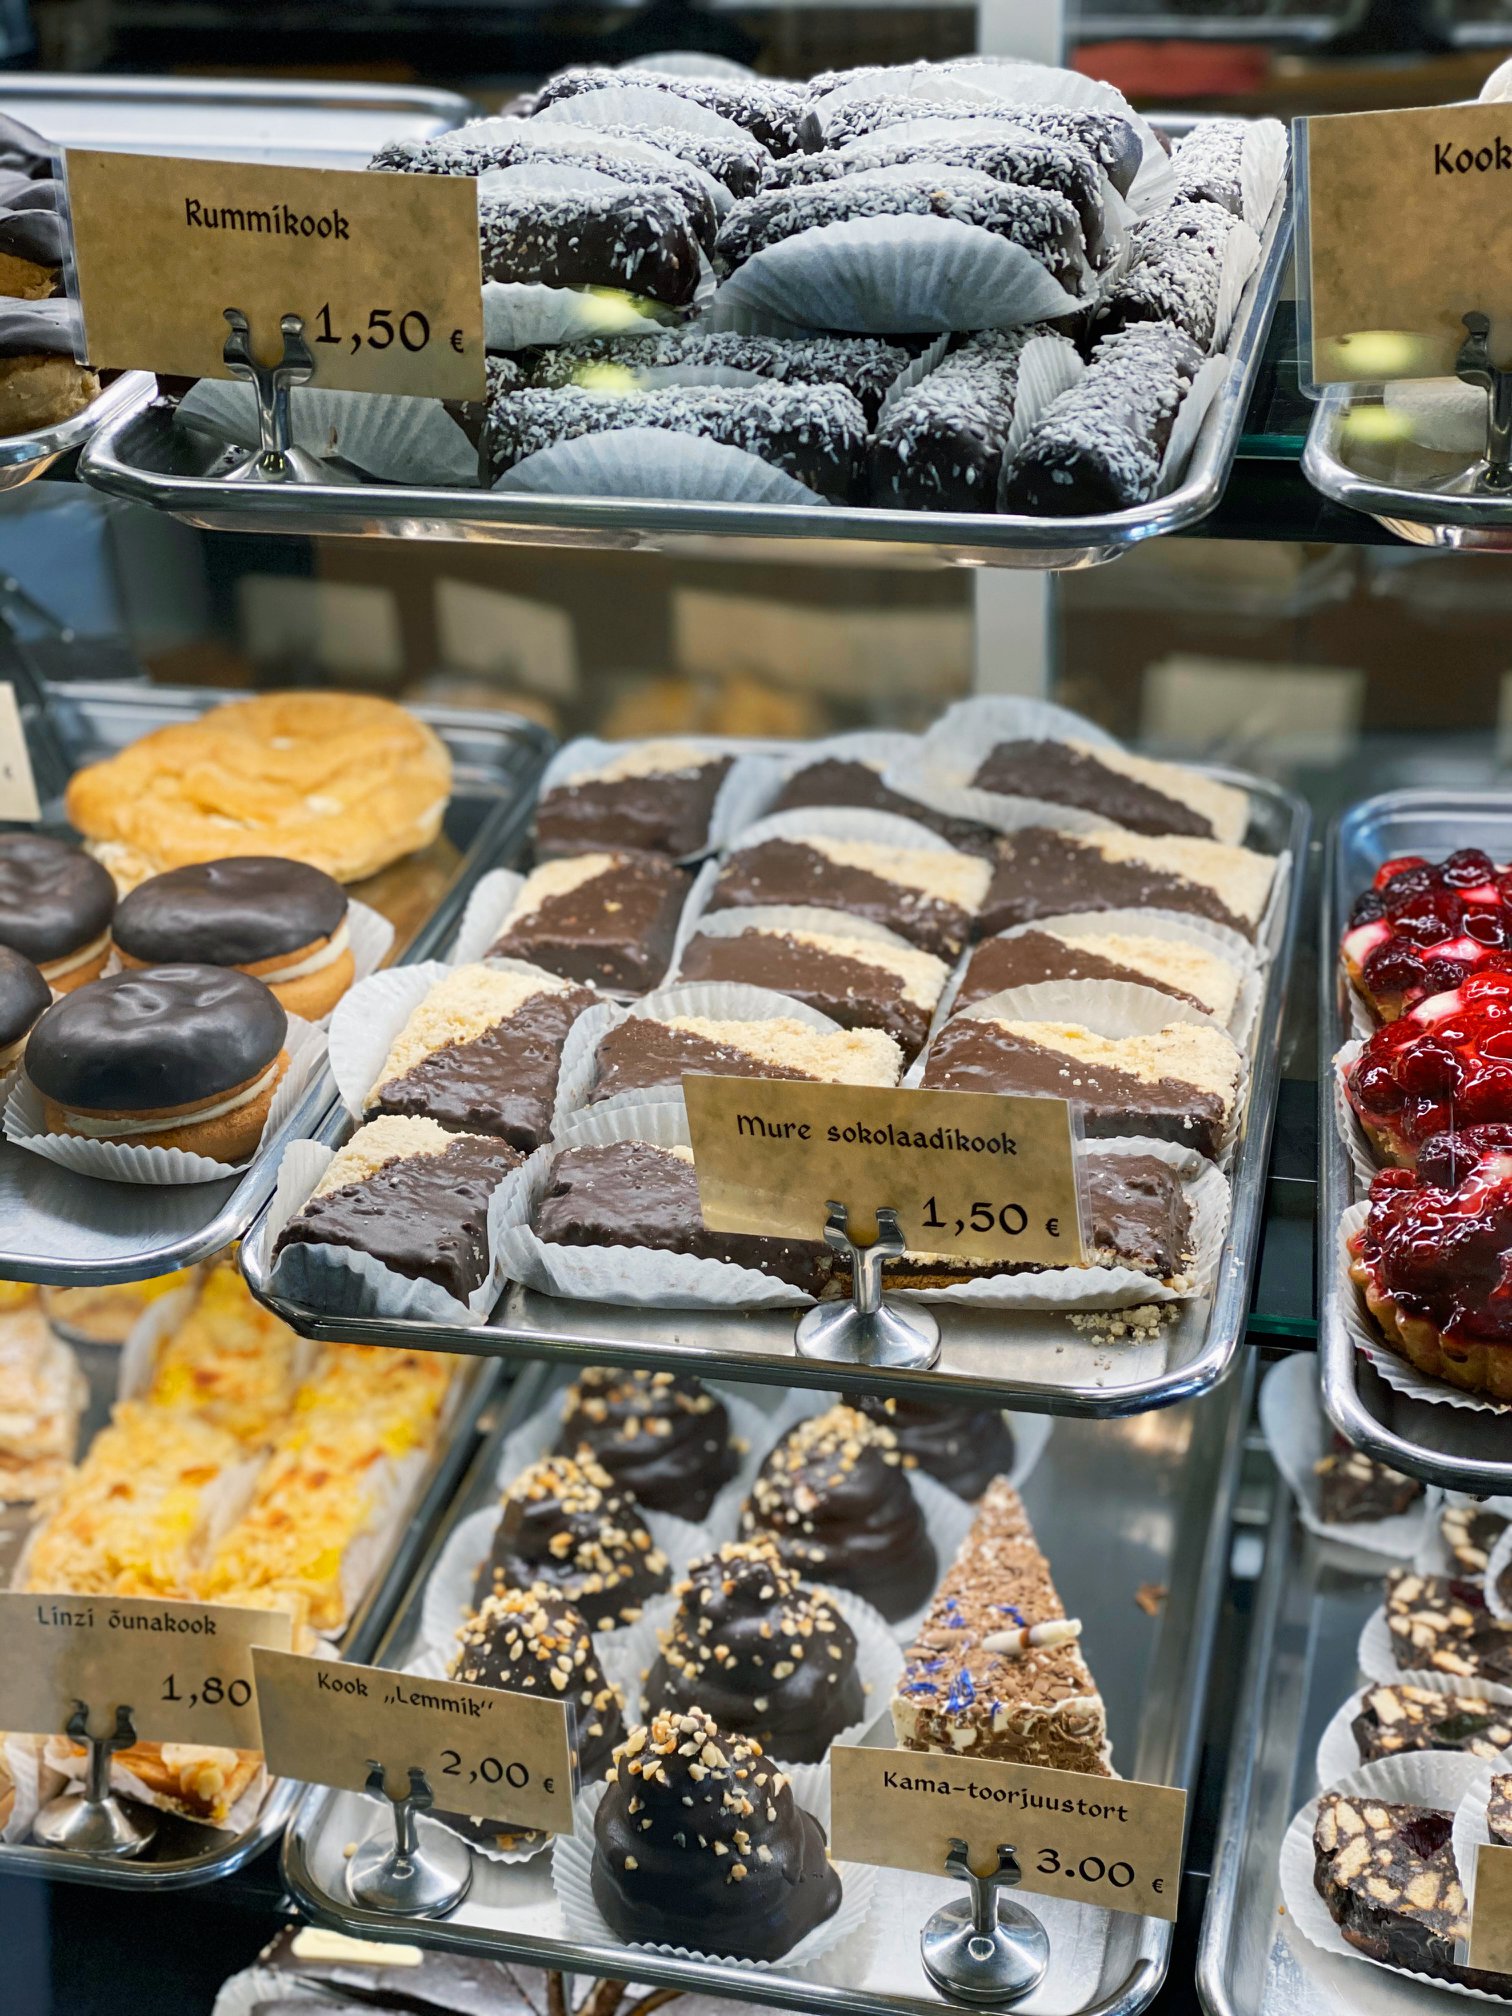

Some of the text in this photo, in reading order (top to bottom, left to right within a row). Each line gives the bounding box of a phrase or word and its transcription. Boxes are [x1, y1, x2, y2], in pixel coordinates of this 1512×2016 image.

[1435, 136, 1512, 175] Kook
[185, 198, 350, 240] Rummikook
[315, 302, 464, 355] 1,50 €
[737, 1114, 1017, 1155] Mure sokolaadikook
[922, 1196, 1060, 1237] 1,50 €
[38, 1606, 217, 1635] Linzi õunakook
[161, 1673, 252, 1709] 1,80
[317, 1672, 368, 1697] Kook
[440, 1750, 555, 1794] 2,00 €
[884, 1771, 1129, 1823] Kama-toorjuustort
[1036, 1848, 1164, 1894] 3.00 €
